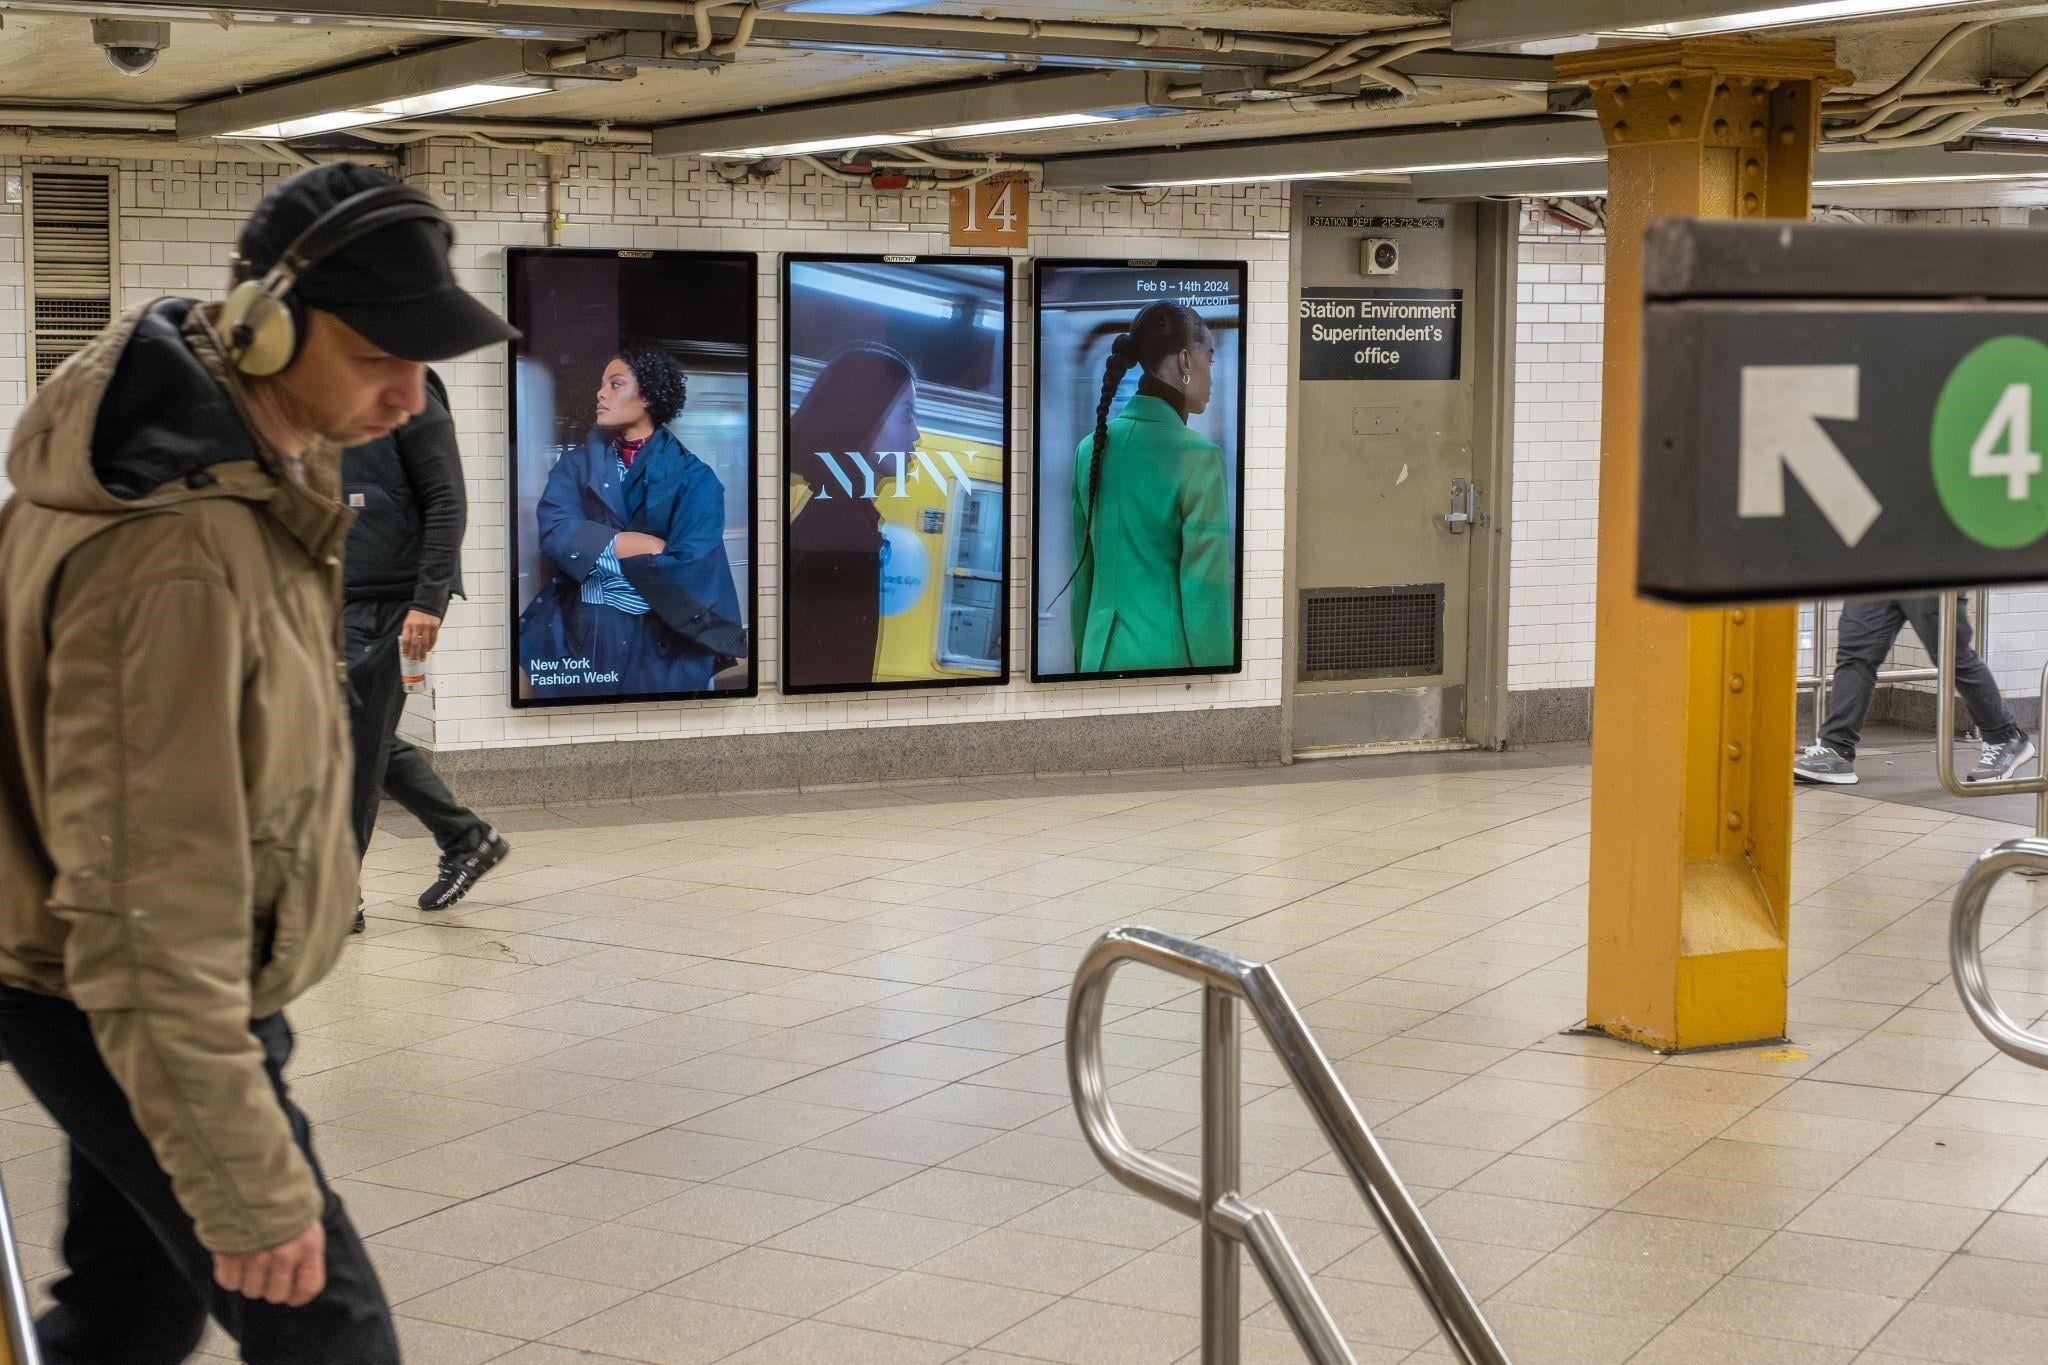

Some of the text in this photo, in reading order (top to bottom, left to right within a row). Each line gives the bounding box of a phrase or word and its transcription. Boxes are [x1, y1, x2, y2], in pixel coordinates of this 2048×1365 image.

[961, 181, 1017, 232] 14
[1313, 216, 1348, 227] STATION
[1352, 217, 1373, 227] DEPT
[1381, 218, 1440, 229] 212-712-4236
[1136, 280, 1157, 292] Feb
[1159, 280, 1167, 292] 9
[1178, 280, 1201, 292] 14th
[1203, 281, 1229, 292] 2024
[1179, 295, 1229, 307] nyfw.com
[1300, 301, 1457, 319] Station Environment
[1311, 323, 1443, 345] Superintendent's
[1354, 347, 1400, 364] office
[1968, 382, 2042, 500] 4
[814, 451, 981, 499] NYFW
[530, 657, 590, 671] New York
[530, 670, 619, 686] Fashion Week
